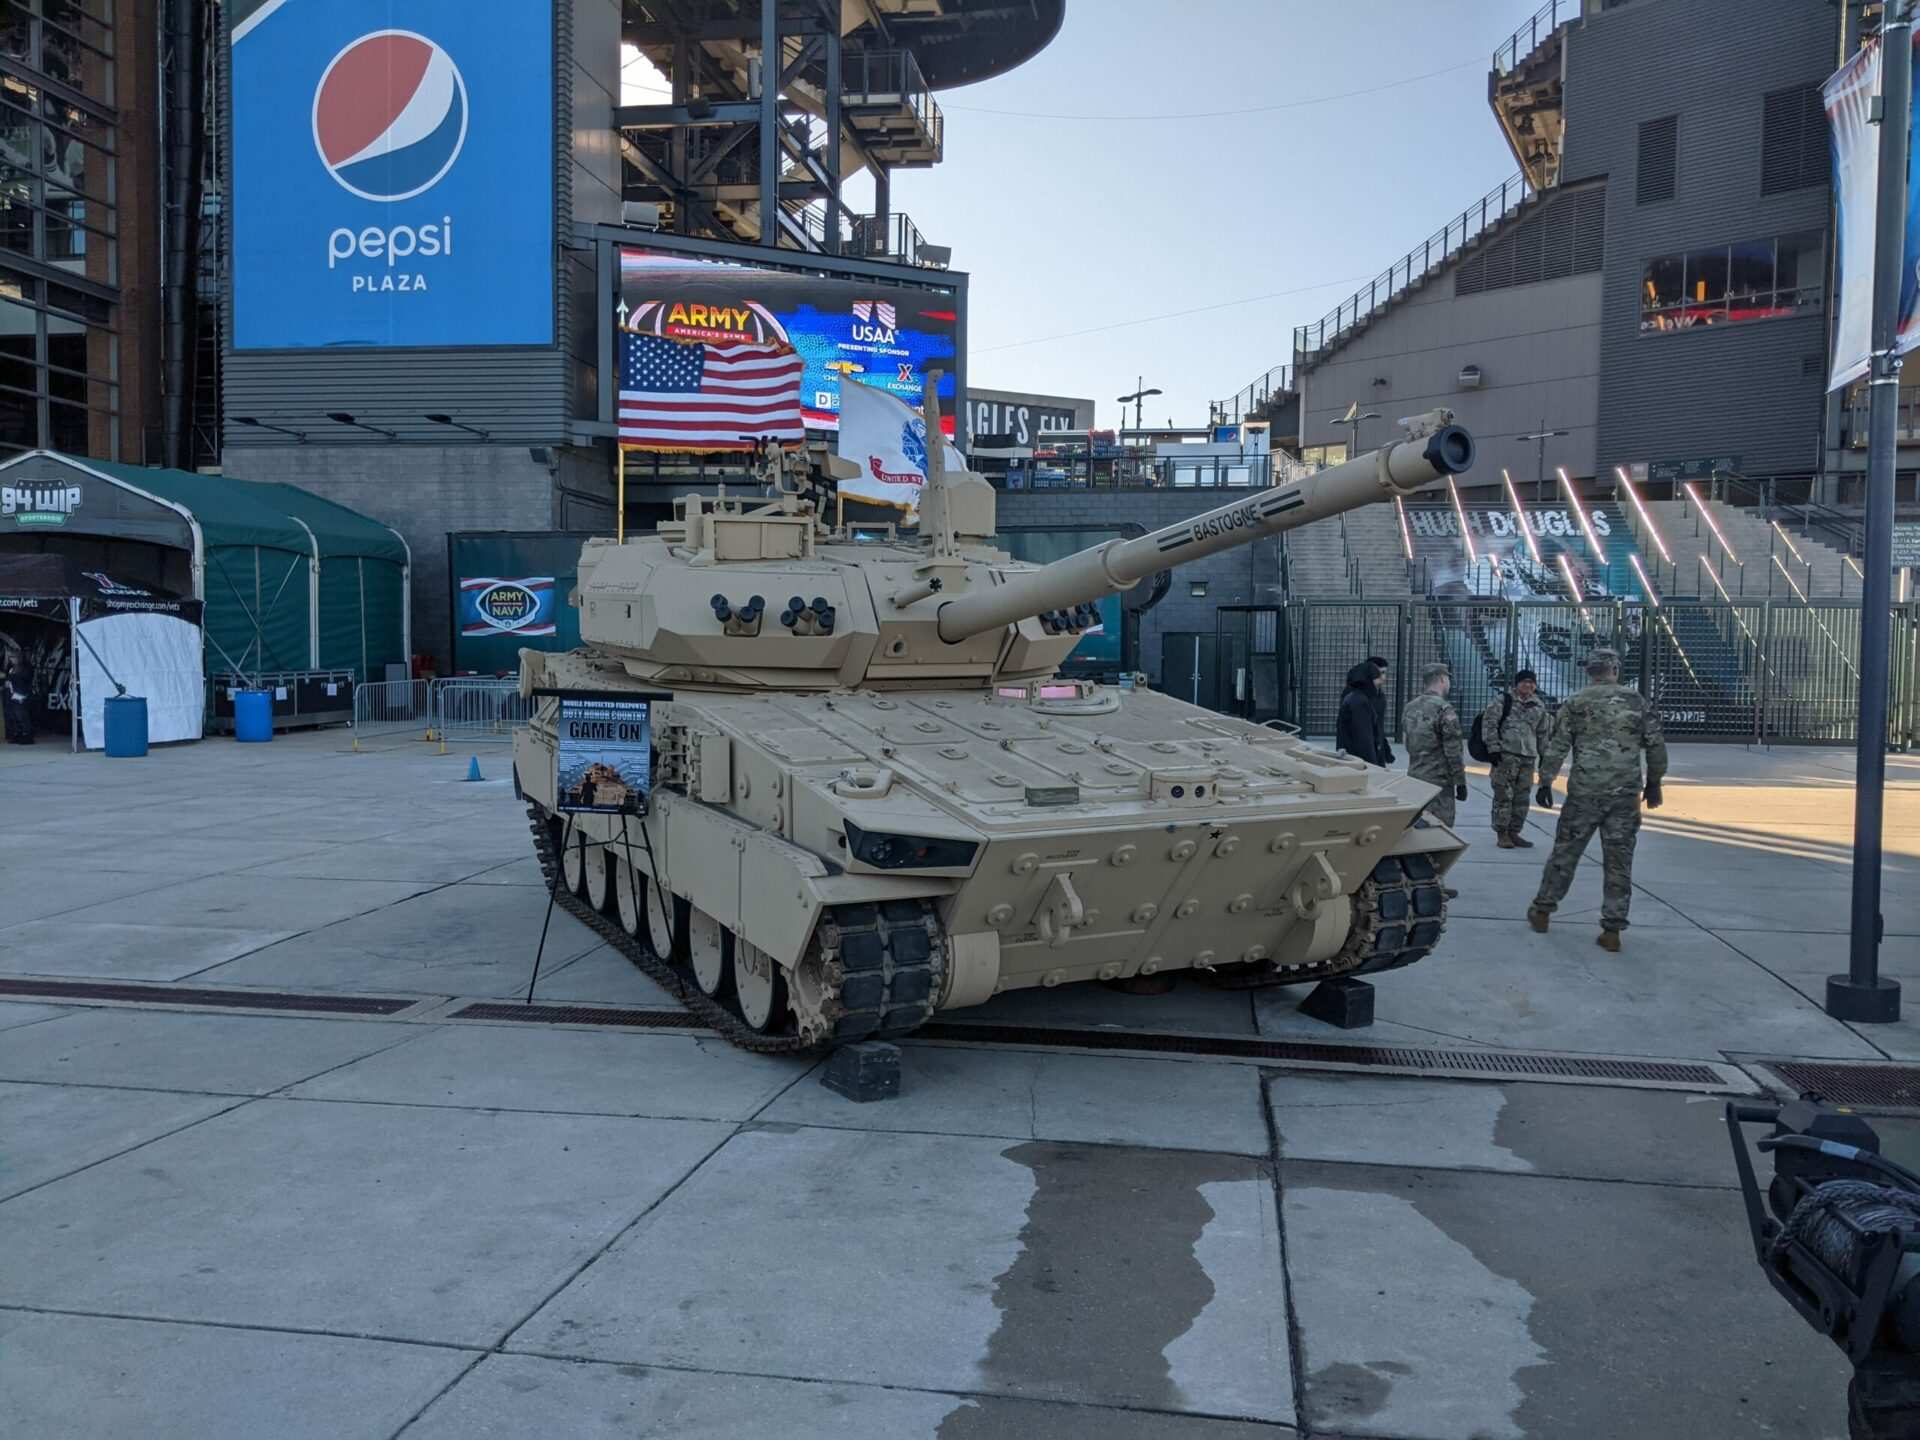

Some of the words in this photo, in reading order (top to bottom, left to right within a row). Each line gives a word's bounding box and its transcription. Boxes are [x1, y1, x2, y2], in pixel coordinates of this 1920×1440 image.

[328, 215, 451, 269] pepsi
[352, 274, 427, 292] PLAZA
[668, 303, 750, 331] ARMY
[852, 324, 895, 344] USAA
[838, 342, 878, 353] PRESENTING
[879, 348, 909, 357] SPONSOR
[888, 383, 922, 392] EXCHANGE
[2, 487, 33, 513] 94
[36, 487, 81, 512] WIP
[1193, 503, 1258, 541] BASTOGNE
[1488, 510, 1611, 536] DOUGLS
[491, 591, 524, 601] ARMY
[492, 606, 524, 616] NAVY
[563, 709, 582, 718] DUTY
[584, 709, 609, 719] HONOR
[612, 710, 646, 720] COUNTRY
[570, 721, 616, 739] GAME
[619, 723, 641, 740] ON
